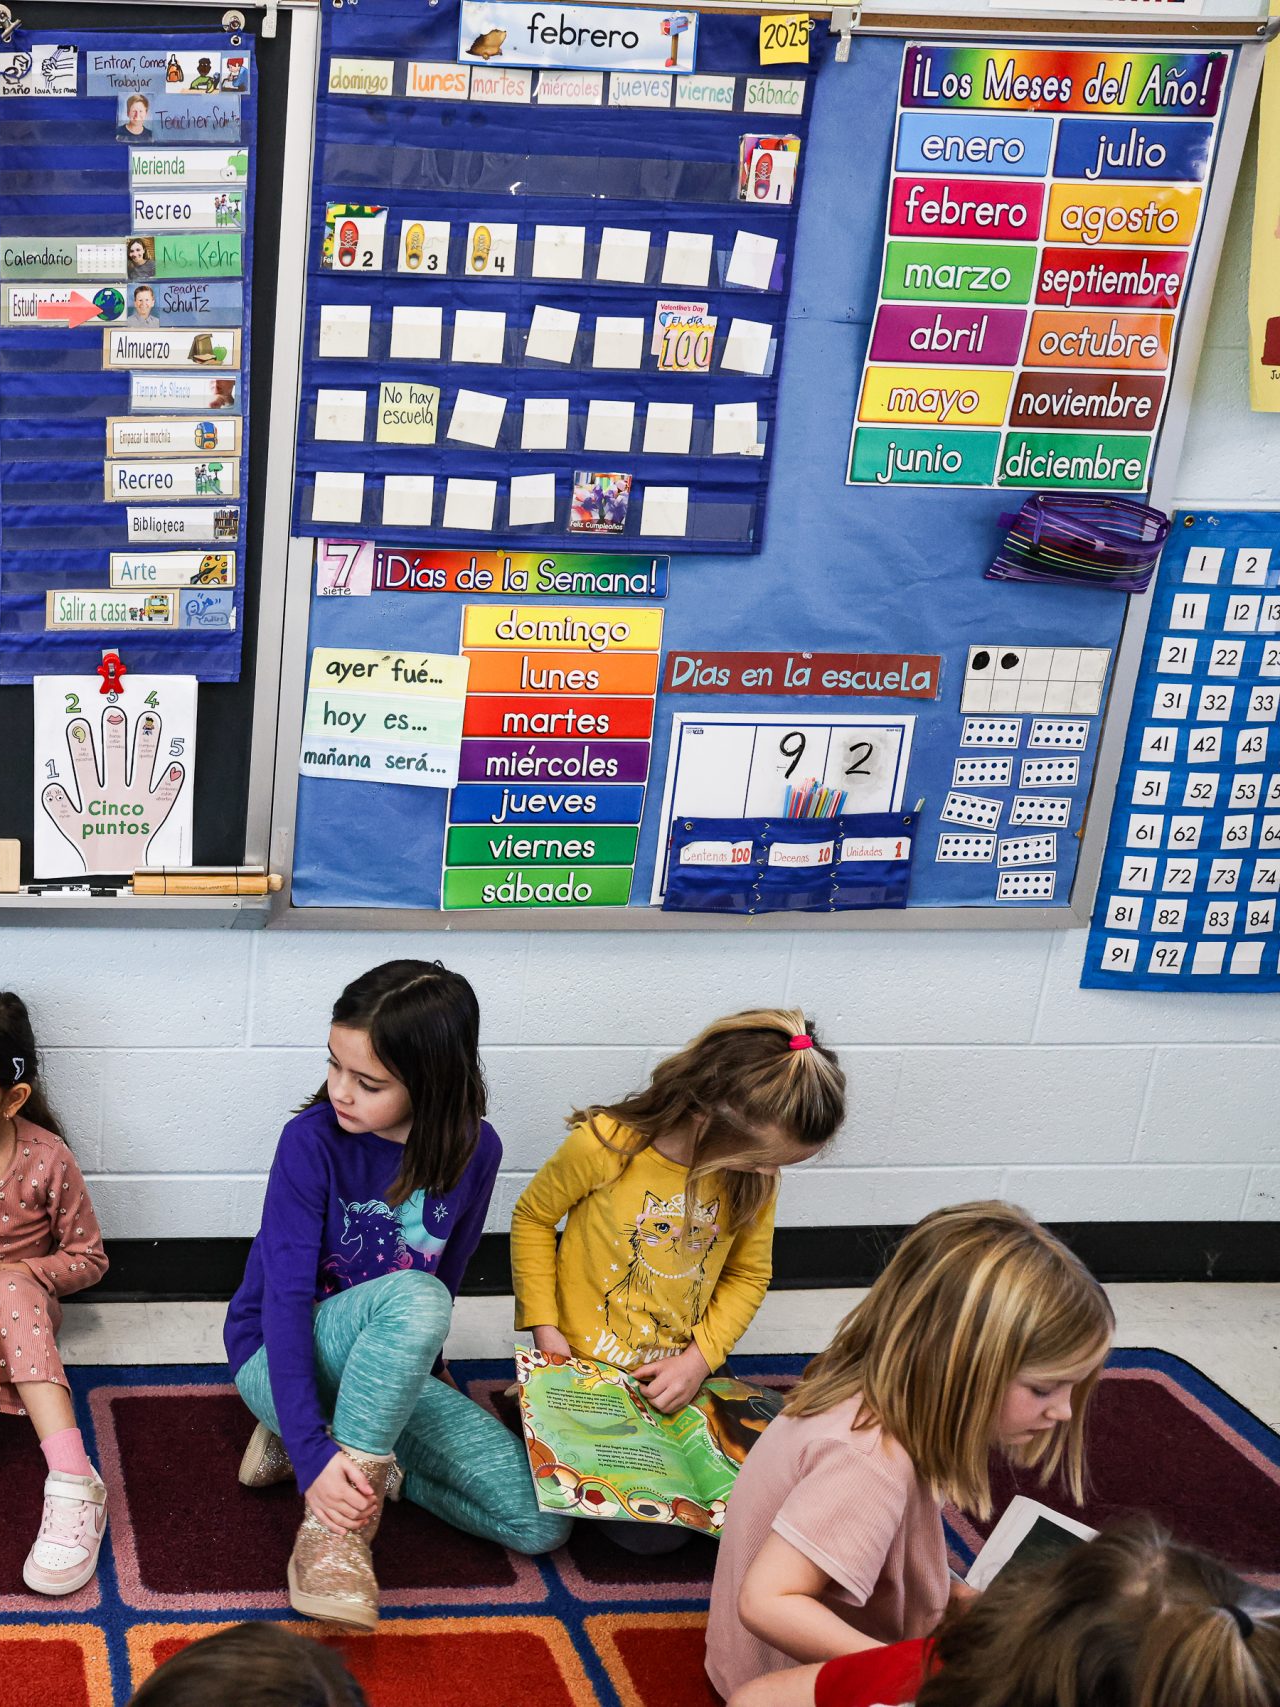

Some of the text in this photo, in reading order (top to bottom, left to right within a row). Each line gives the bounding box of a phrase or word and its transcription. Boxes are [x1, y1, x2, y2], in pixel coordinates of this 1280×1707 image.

[527, 12, 639, 50] febrero
[764, 21, 810, 51] 2025
[106, 74, 152, 92] Trabajar
[330, 66, 389, 95] domingo
[412, 67, 466, 92] lunes
[473, 76, 524, 95] martes
[539, 76, 600, 99] miércoles
[612, 77, 671, 103] jueves
[912, 55, 1213, 106] ¡Los Meses del Año!
[679, 84, 734, 105] viernes
[748, 81, 799, 106] sábado
[920, 132, 1025, 164] enero
[1085, 128, 1166, 180] julio
[132, 157, 185, 175] Merienda
[134, 200, 192, 220] Recreo
[905, 186, 1027, 228] febrero
[1061, 201, 1179, 244] agosto
[3, 249, 73, 267] Calendario
[903, 261, 1011, 290] marzo
[1042, 259, 1180, 307] septiembre
[169, 283, 210, 295] Teacher
[162, 295, 210, 313] Schutz
[909, 314, 987, 353] abril
[1039, 320, 1158, 357] octubre
[116, 336, 170, 359] Almuerzo
[662, 329, 714, 368] 100
[384, 385, 433, 412] No hay
[887, 383, 980, 421] mayo
[1019, 382, 1152, 417] noviembre
[383, 407, 433, 427] escuela
[875, 443, 962, 482] junio
[1005, 443, 1142, 480] diciembre
[119, 469, 173, 490] Recreo
[133, 517, 185, 533] Biblioteca
[121, 561, 157, 580] Arte
[375, 554, 657, 594] ¡Días de la Semana!
[59, 597, 127, 622] Salir a casa
[496, 609, 631, 652] domingo
[325, 659, 379, 684] ayer
[520, 656, 600, 690] lunes
[671, 656, 931, 691] Dias en la escuela
[323, 702, 366, 732] hoy
[502, 709, 609, 734] martes
[304, 748, 371, 769] mañana
[485, 745, 618, 777] miércoles
[779, 731, 806, 779] 9
[844, 742, 874, 775] 2
[88, 800, 144, 816] Cinco
[491, 788, 597, 824] jueves
[82, 820, 150, 840] puntos
[489, 834, 596, 859] viernes
[683, 846, 728, 863] Centenas
[774, 852, 809, 863] Decenas
[846, 846, 882, 858] Unidades
[481, 872, 593, 904] sábado
[1115, 906, 1230, 928] 81 82 83
[1111, 948, 1180, 969] 91 92
